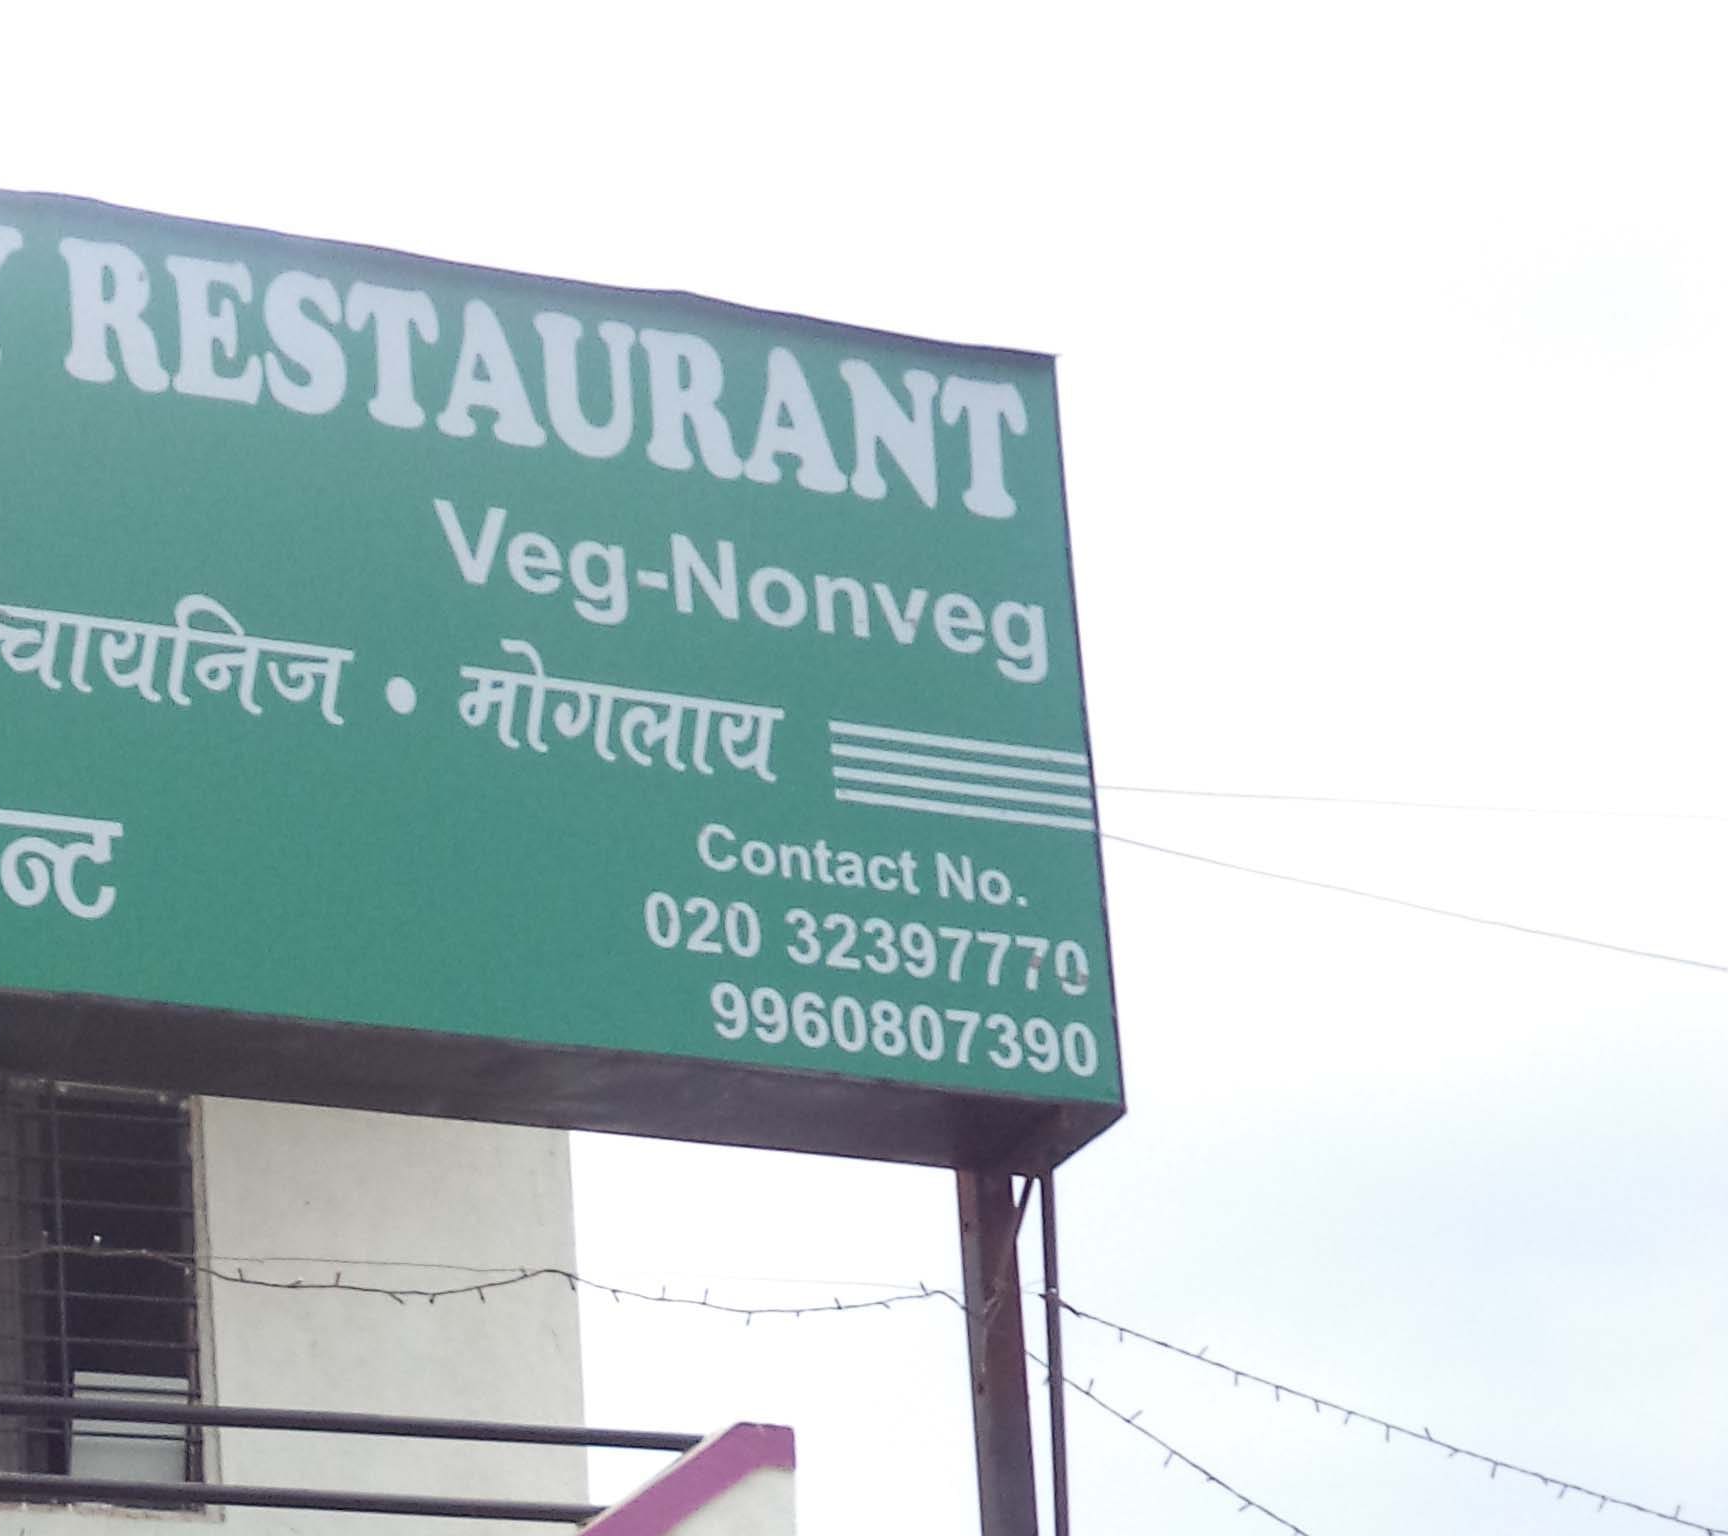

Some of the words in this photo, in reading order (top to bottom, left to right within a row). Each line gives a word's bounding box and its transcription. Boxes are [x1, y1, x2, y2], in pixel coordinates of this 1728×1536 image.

[57, 235, 1029, 520] RESTAURANT
[433, 498, 1049, 685] Veg-Nonveg
[459, 638, 786, 783] मोगलाय
[697, 823, 920, 897] Contact
[935, 852, 1029, 908] No.
[644, 891, 762, 958] 020
[784, 908, 1090, 997] 32397770
[711, 981, 1098, 1078] 9960807390
